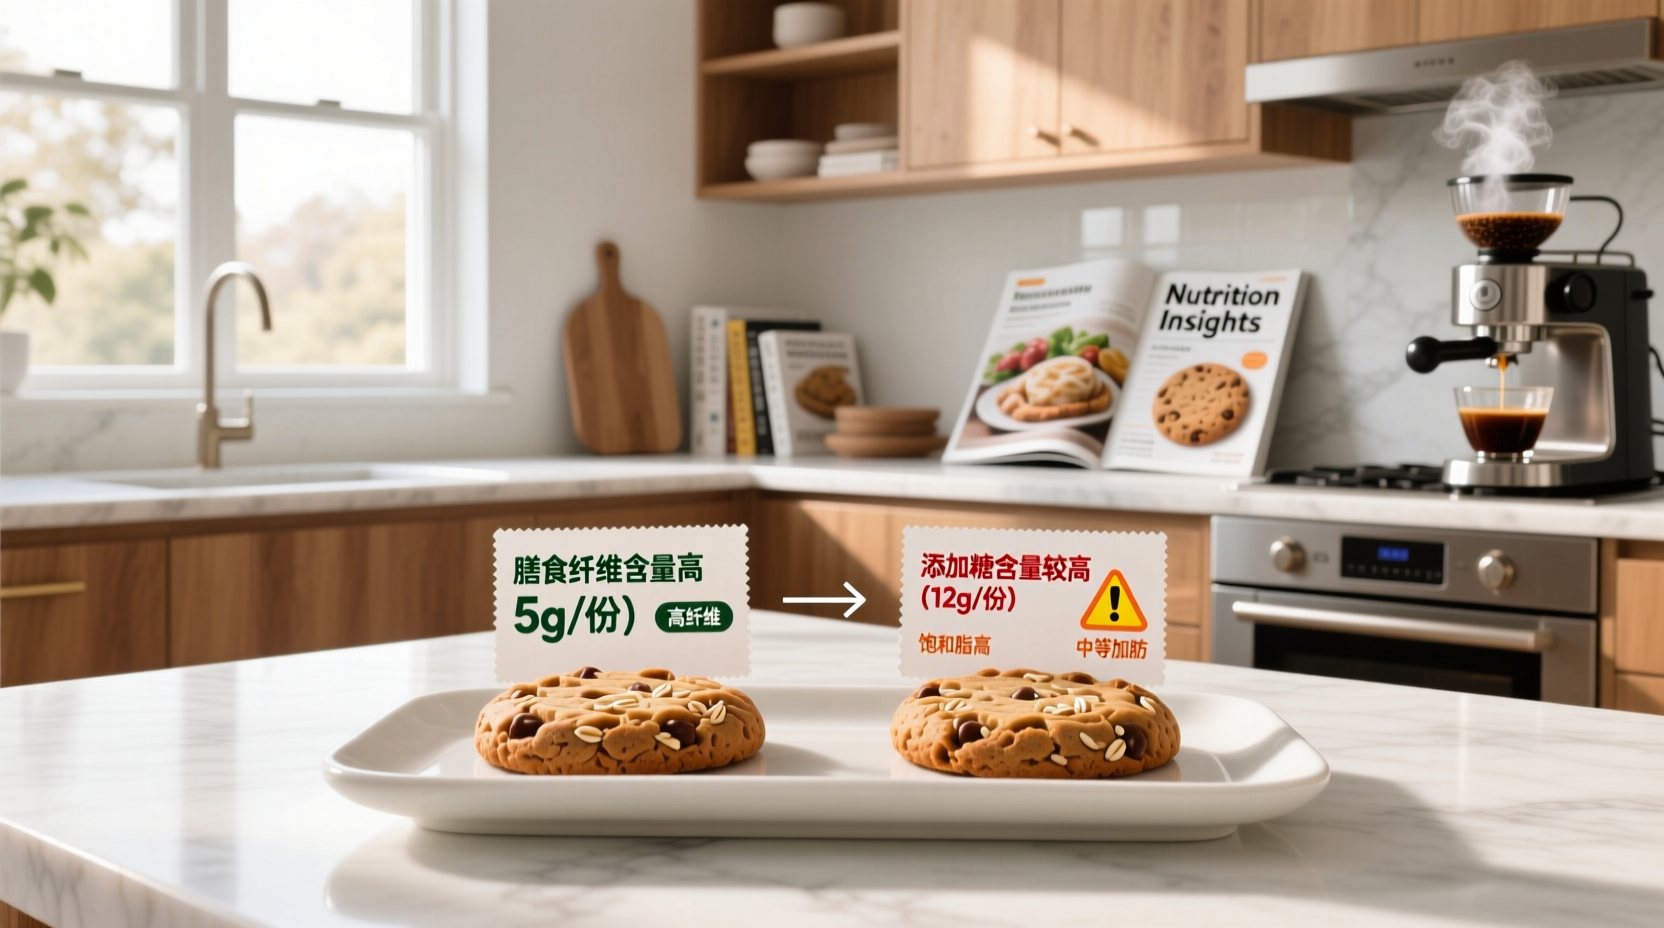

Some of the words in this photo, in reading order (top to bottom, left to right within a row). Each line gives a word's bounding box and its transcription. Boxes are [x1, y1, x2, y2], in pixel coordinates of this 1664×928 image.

[1165, 283, 1280, 306] Nutrition
[1159, 309, 1262, 339] Insights
[513, 552, 703, 585] 膳食纤维含量高
[920, 552, 1092, 582] 添加糖含量较高
[921, 584, 1016, 615] (12g/份)
[514, 595, 635, 643] 5g/份)
[667, 606, 722, 628] 高纤维
[918, 632, 992, 656] 饱和脂高
[1076, 637, 1148, 660] 中等加肪
